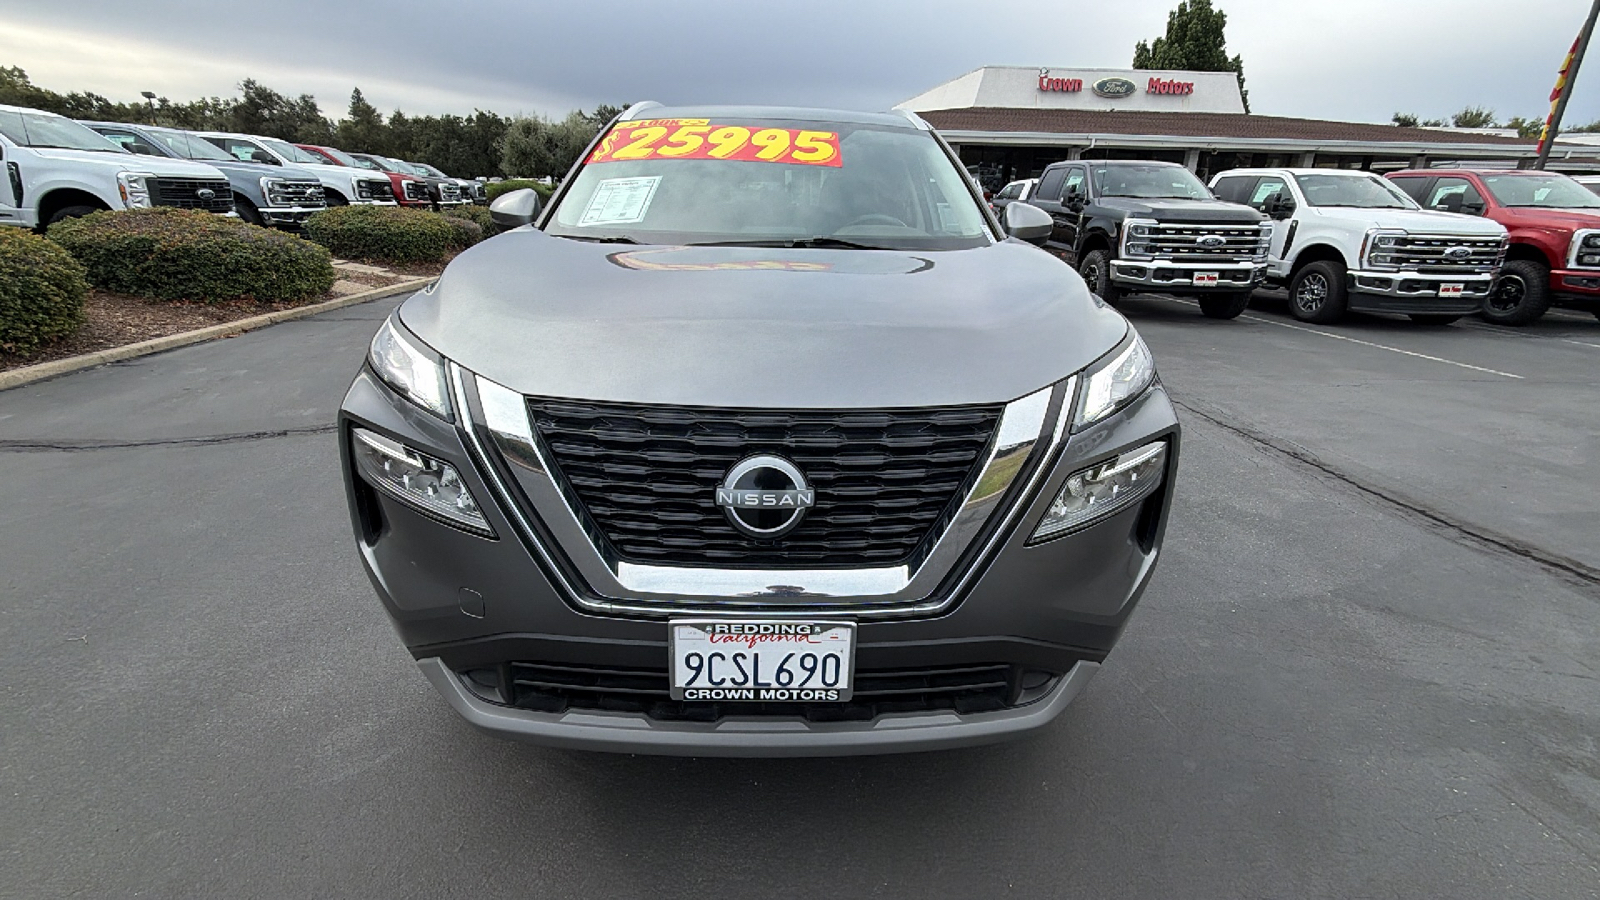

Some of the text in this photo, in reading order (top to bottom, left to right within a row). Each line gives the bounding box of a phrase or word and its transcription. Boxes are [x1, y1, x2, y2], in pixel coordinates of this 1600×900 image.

[1038, 75, 1194, 95] Crown Ford Motors
[638, 119, 681, 127] LOOK
[593, 126, 837, 163] $25995
[719, 491, 811, 506] NISSAN
[714, 624, 811, 634] REDDING
[684, 652, 841, 688] 9CSL690
[684, 689, 839, 700] CROWN MOTORS
